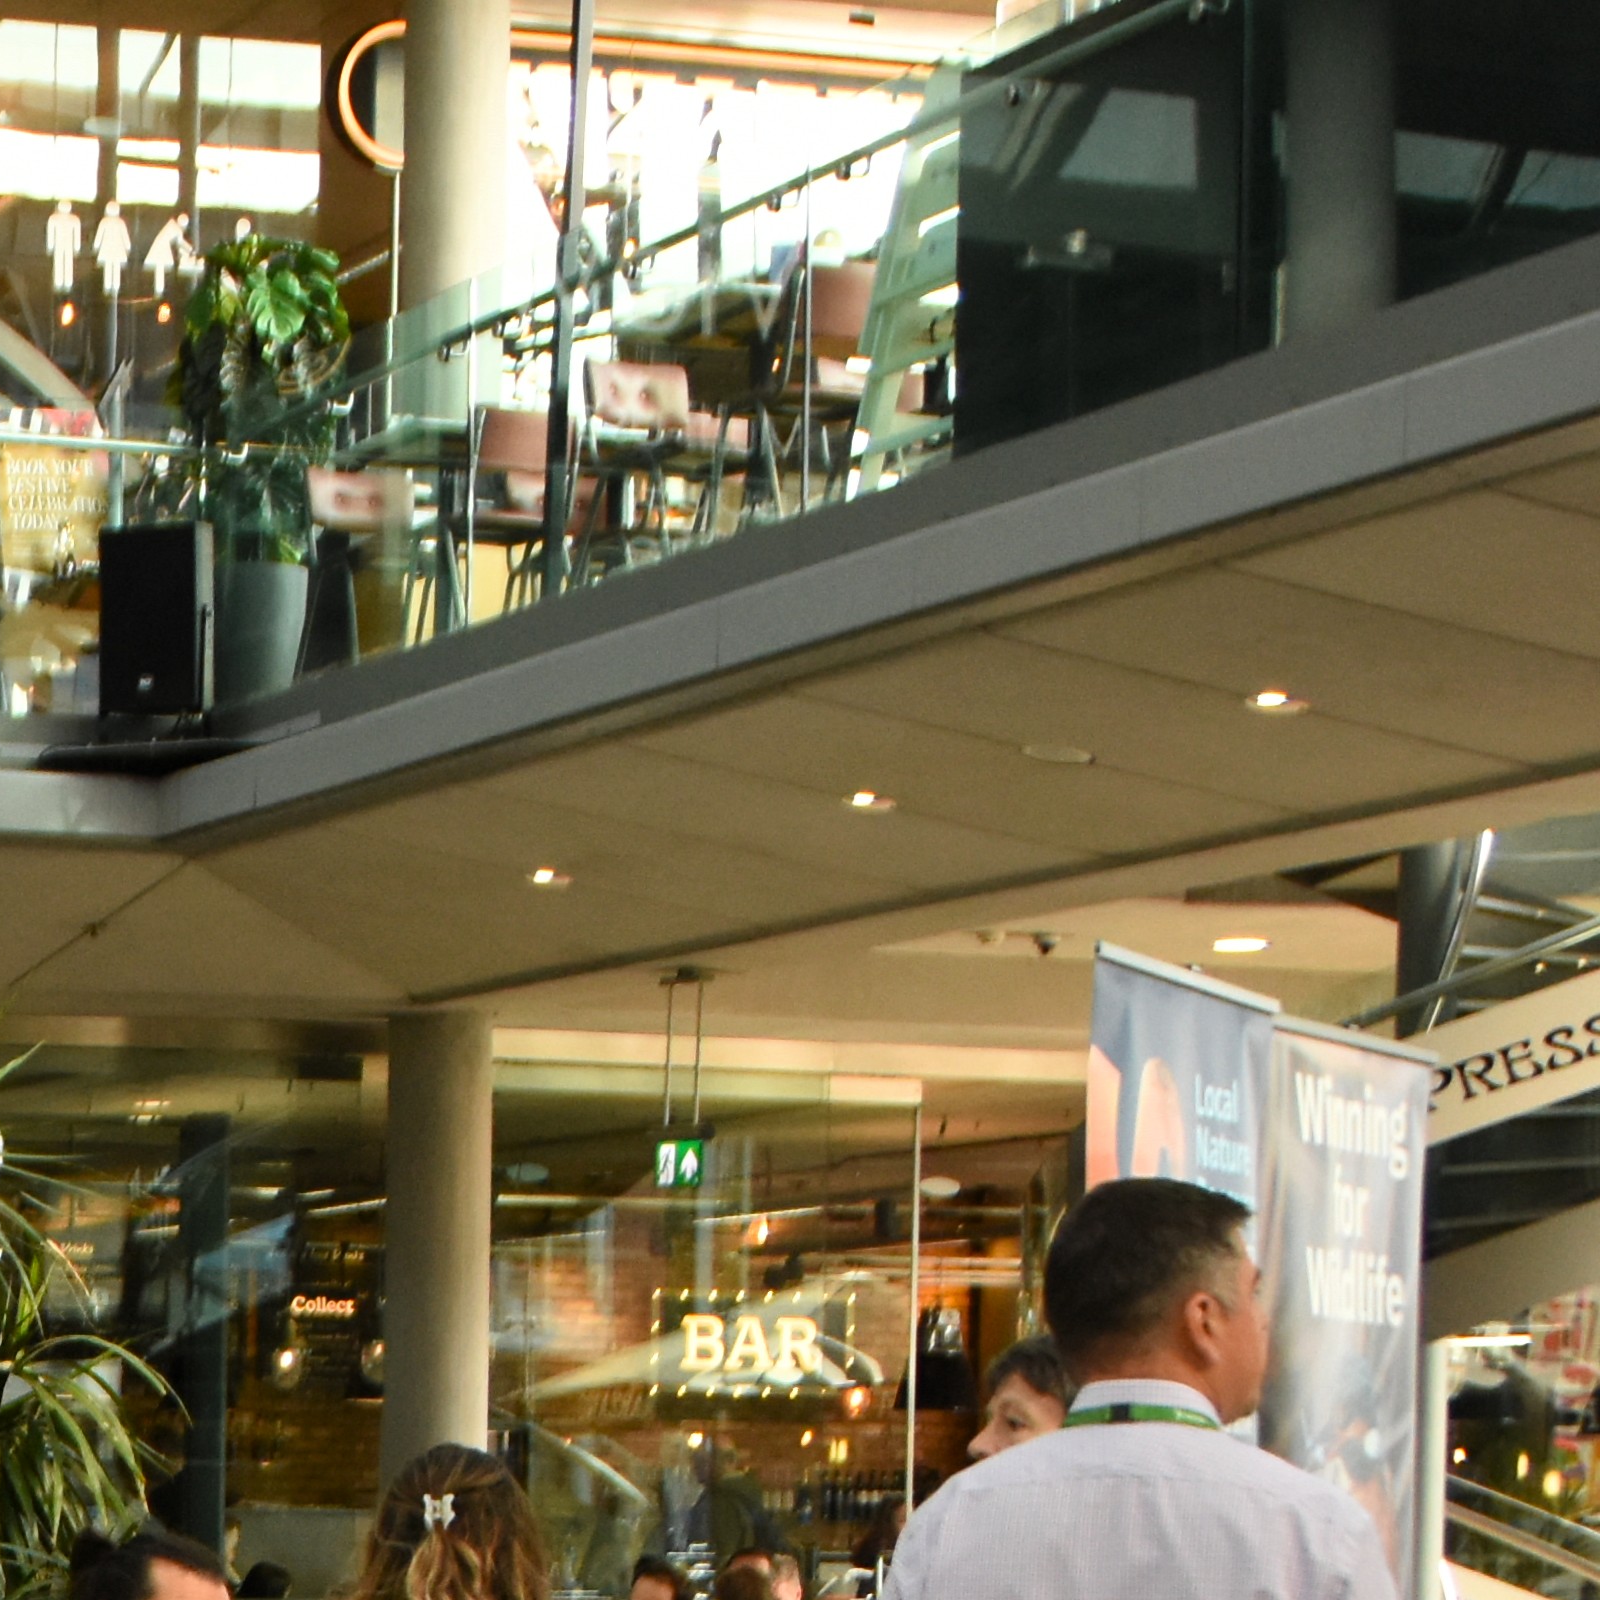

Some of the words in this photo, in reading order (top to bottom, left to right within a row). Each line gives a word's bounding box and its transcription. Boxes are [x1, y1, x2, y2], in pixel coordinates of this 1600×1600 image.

[7, 457, 49, 476] BOOK
[12, 512, 60, 531] TODAY
[1196, 1074, 1240, 1122] Local
[1295, 1072, 1408, 1179] Winning
[1333, 1164, 1369, 1237] for
[291, 1296, 356, 1316] Collect
[1305, 1246, 1404, 1327] Wildlife
[679, 1313, 822, 1372] BAR
